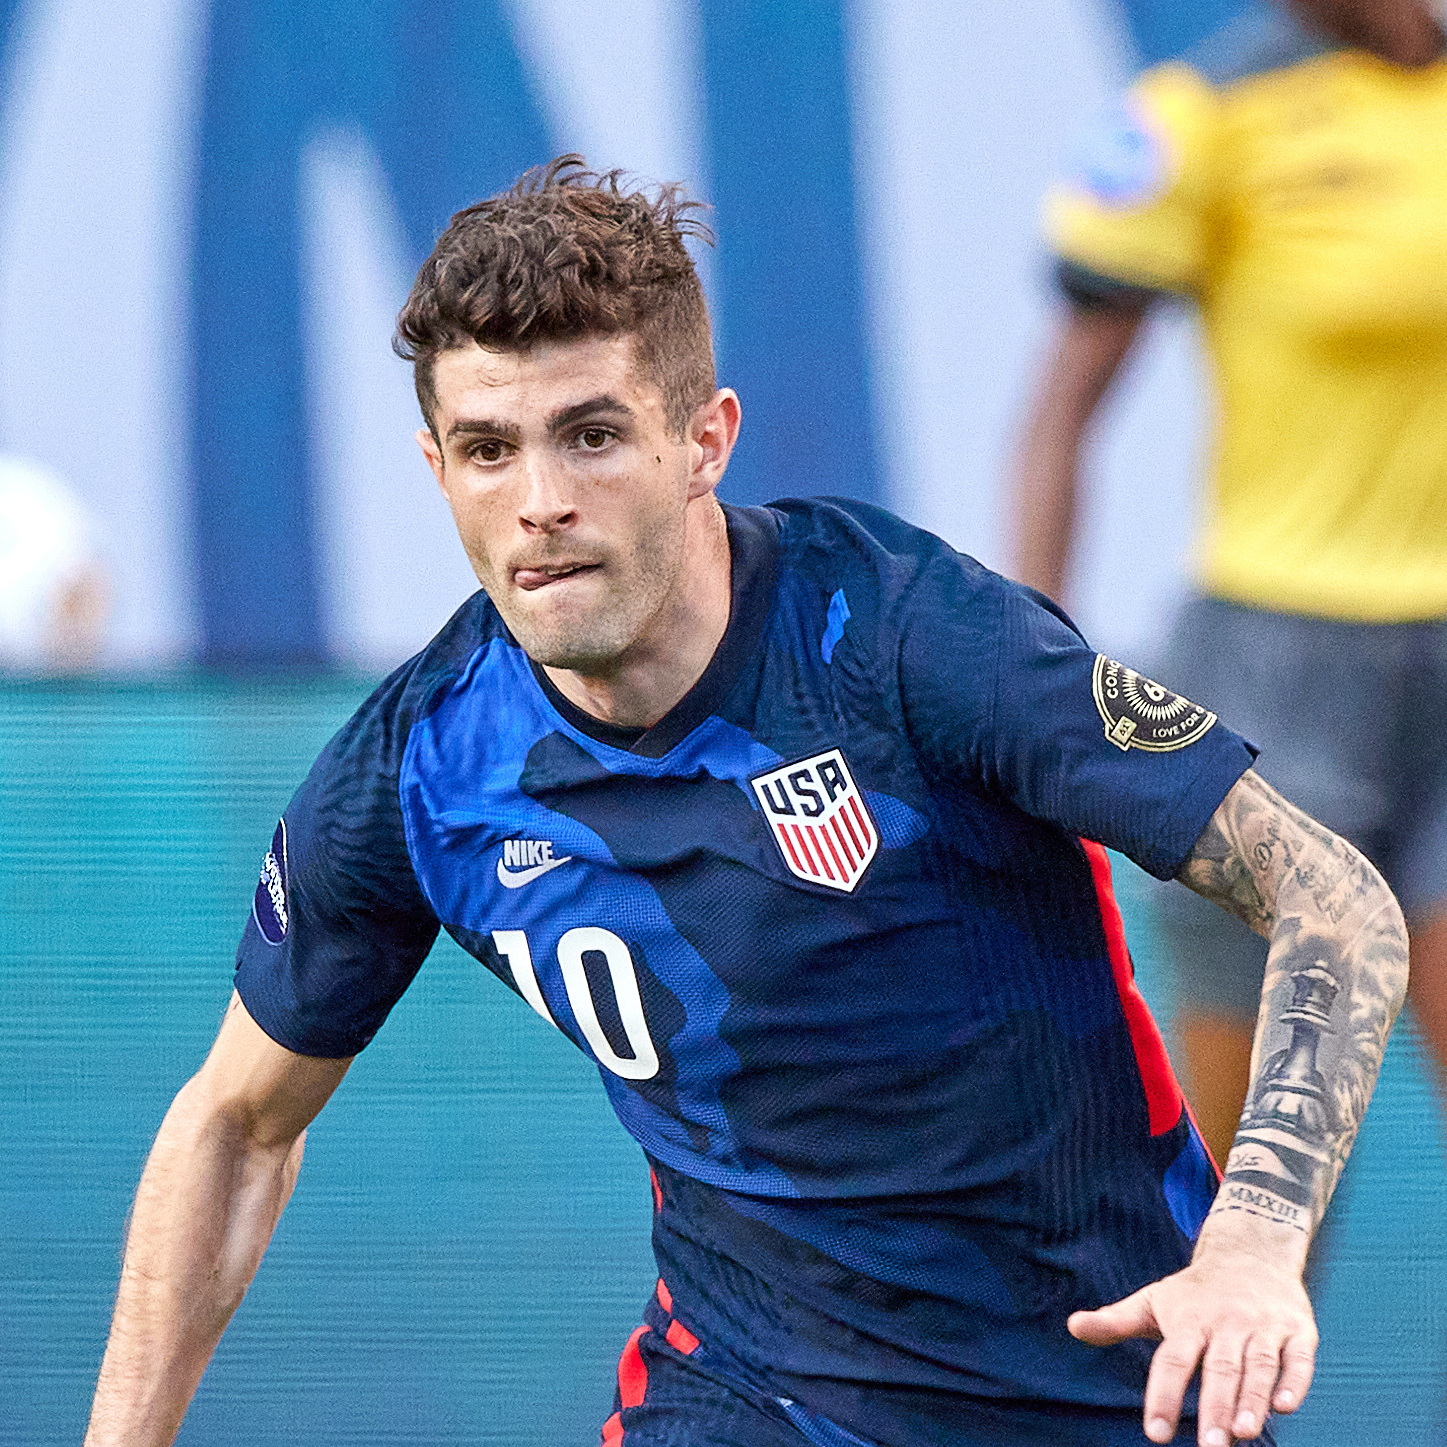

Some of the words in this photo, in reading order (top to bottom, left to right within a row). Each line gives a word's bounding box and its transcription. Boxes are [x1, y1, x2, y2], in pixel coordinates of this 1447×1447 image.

[1152, 725, 1180, 738] LOVE
[1180, 712, 1200, 731] FOR
[761, 758, 848, 817] USA
[504, 840, 553, 867] NIKE
[491, 926, 660, 1081] 10
